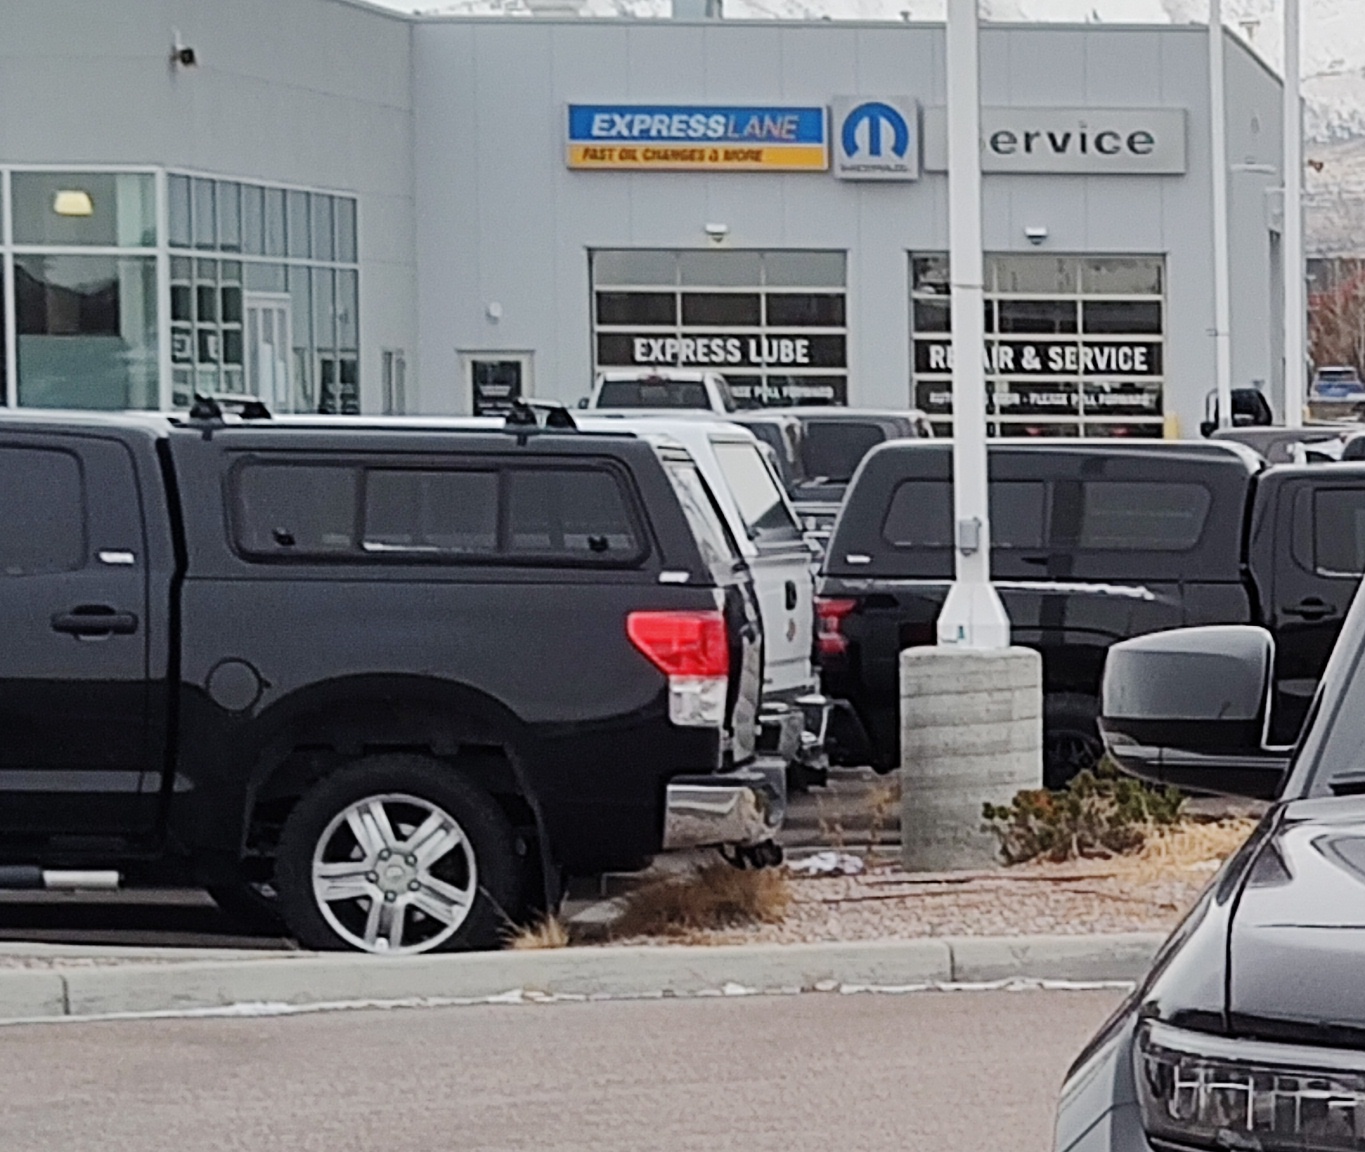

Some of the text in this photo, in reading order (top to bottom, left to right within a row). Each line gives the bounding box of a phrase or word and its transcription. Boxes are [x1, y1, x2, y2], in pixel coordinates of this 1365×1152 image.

[980, 110, 1156, 155] ervice
[634, 338, 809, 364] EXPRESS LUBE
[929, 345, 1148, 371] RAIR & SERVICE
